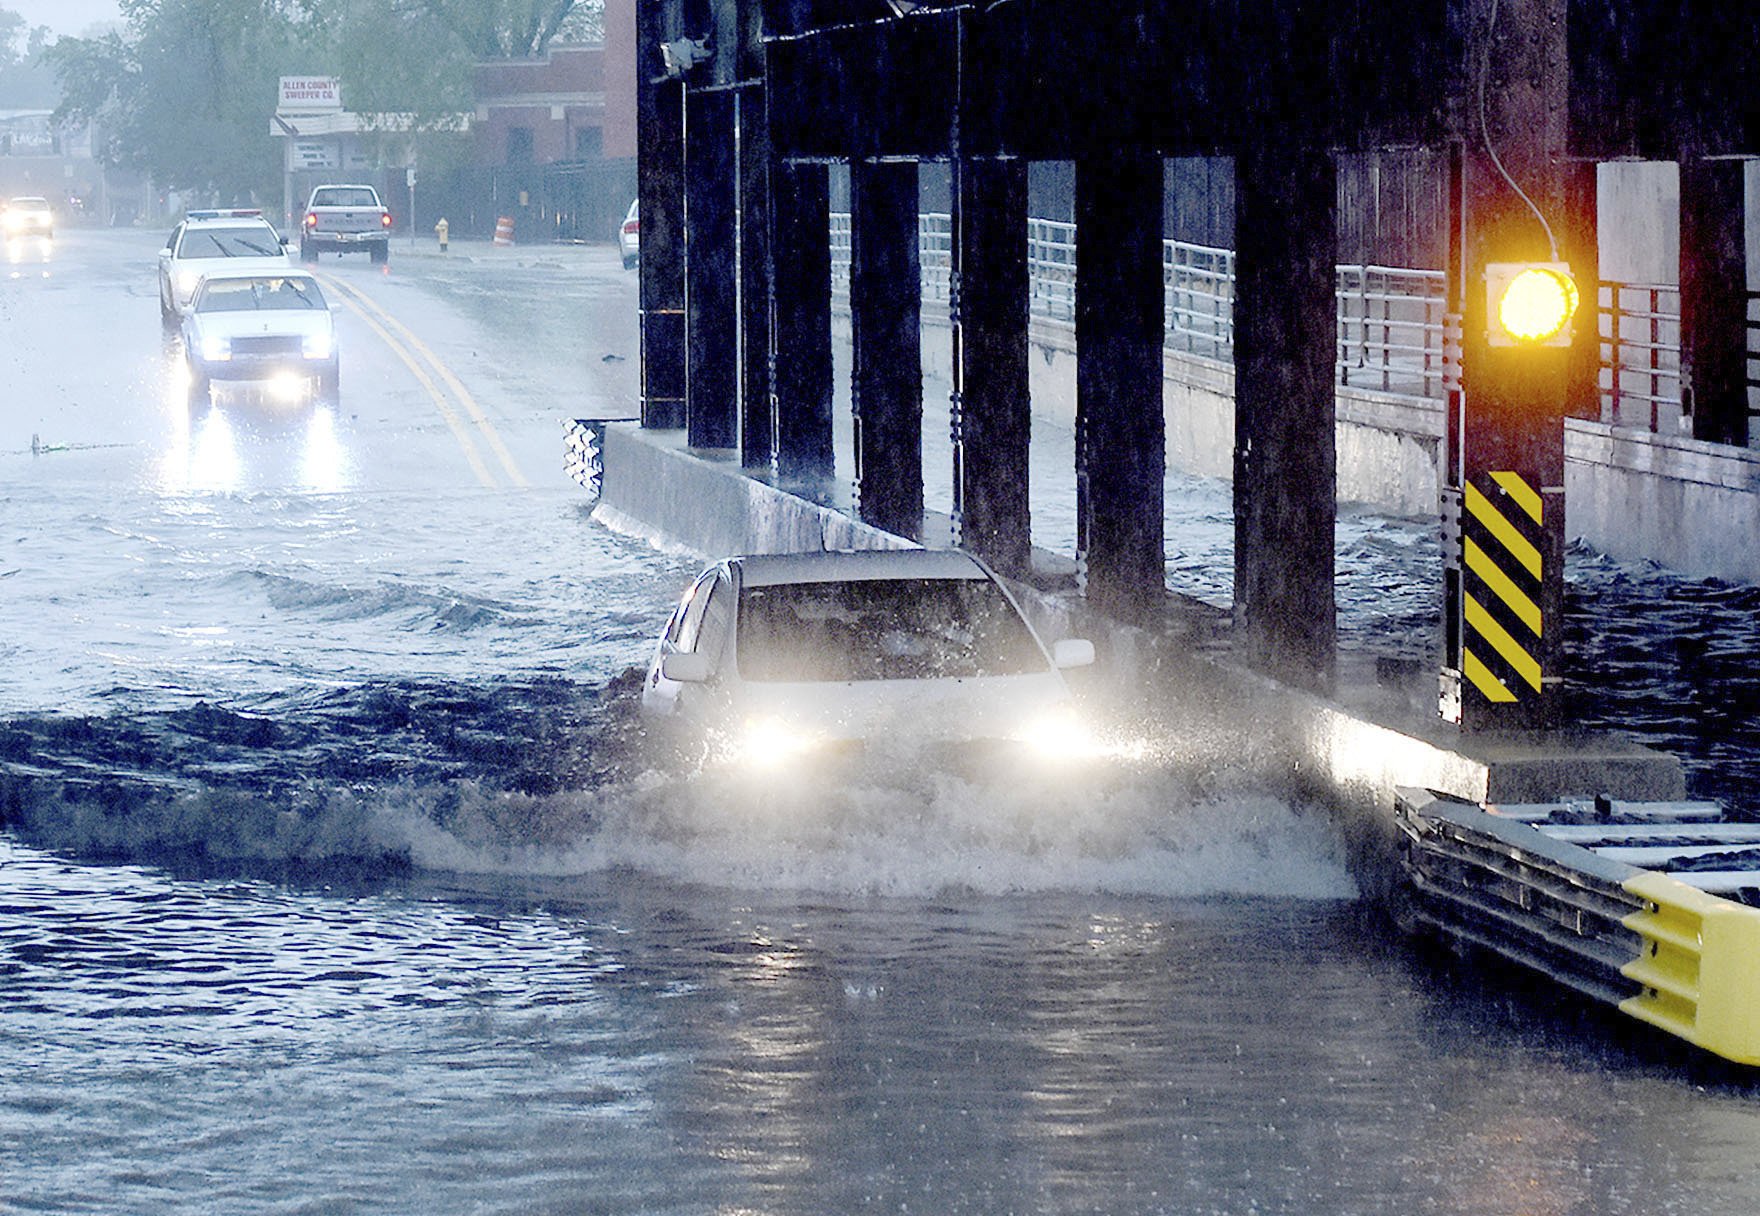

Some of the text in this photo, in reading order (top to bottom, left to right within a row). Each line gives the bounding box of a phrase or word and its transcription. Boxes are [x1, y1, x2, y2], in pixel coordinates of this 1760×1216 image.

[283, 80, 337, 89] ALLEN COUNTY
[285, 91, 320, 99] SWEEPER
